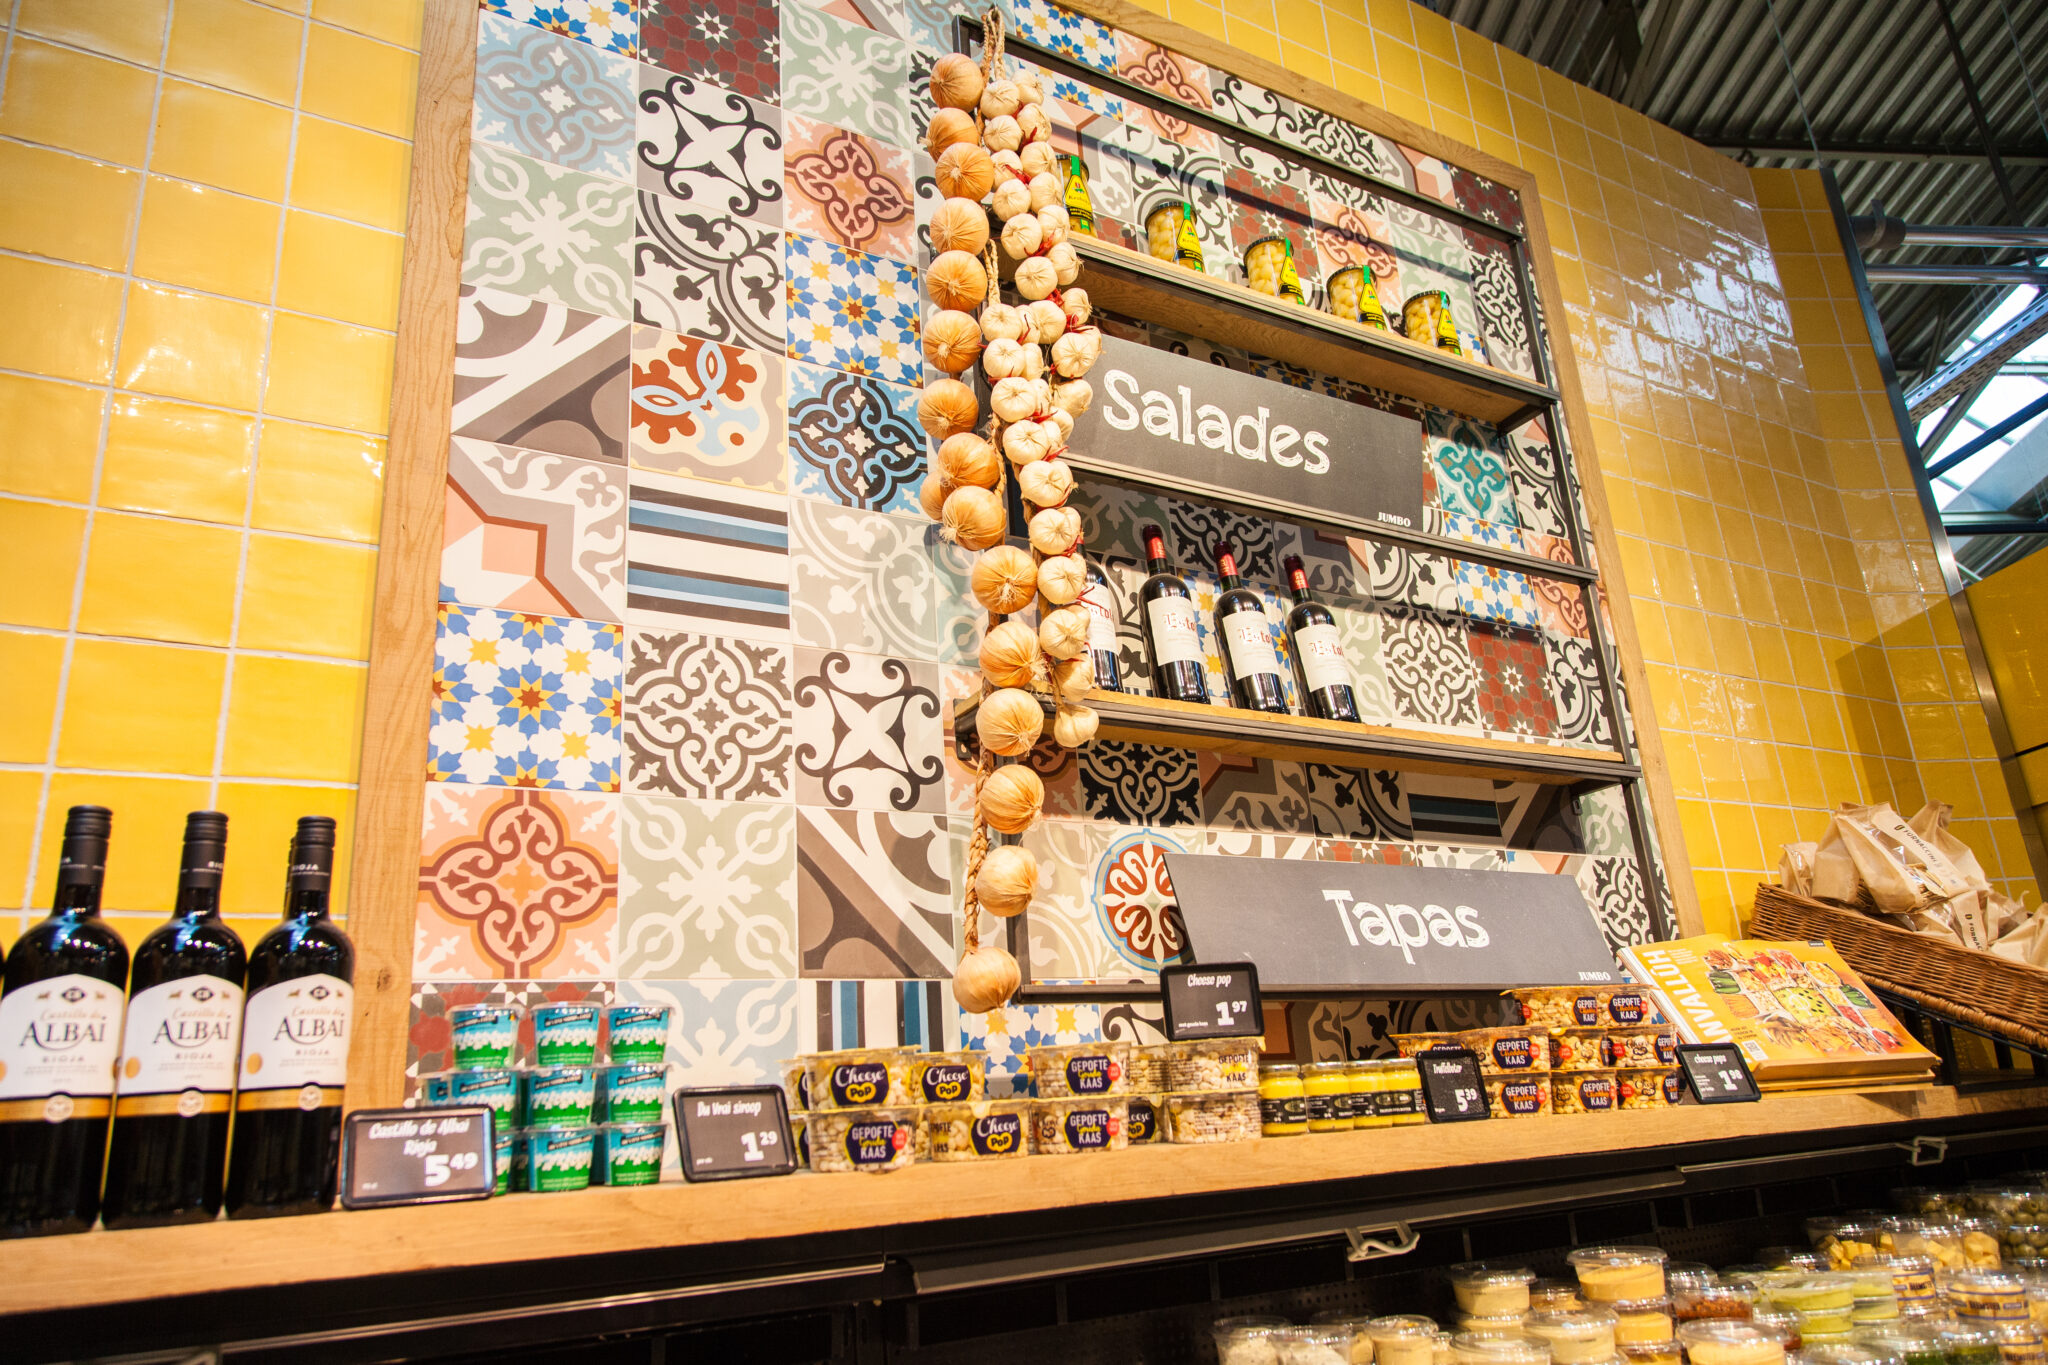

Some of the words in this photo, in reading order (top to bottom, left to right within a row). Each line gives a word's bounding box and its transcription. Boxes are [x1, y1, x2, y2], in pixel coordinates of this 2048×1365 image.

[1103, 369, 1330, 475] Salades
[1377, 511, 1411, 528] JUMBO
[1321, 889, 1490, 966] Tapas
[1187, 973, 1215, 988] Cheese
[1215, 974, 1232, 988] pop
[1578, 971, 1612, 982] JUMBO
[1612, 997, 1641, 1007] GEPOFTE
[1619, 1011, 1638, 1020] KAAS
[1496, 1040, 1530, 1051] GEPOFTE
[1071, 1059, 1108, 1073] GEPOFTE
[1505, 1055, 1526, 1065] KAAS
[834, 1066, 886, 1088] Cheese
[926, 1067, 969, 1086] Cheese
[1080, 1077, 1103, 1089] KAAS
[1505, 1085, 1537, 1096] GEPOFTE
[1583, 1083, 1610, 1092] GEPOFTE
[1513, 1101, 1534, 1110] KAAS
[1590, 1096, 1608, 1106] KAAS
[712, 1101, 731, 1116] Vrai
[1069, 1113, 1108, 1127] GEPOFTE
[419, 1119, 438, 1136] de
[851, 1124, 894, 1140] GEPOFTE
[976, 1117, 1019, 1138] Cheese
[1078, 1131, 1102, 1144] KAAS
[860, 1146, 887, 1160] KAAS
